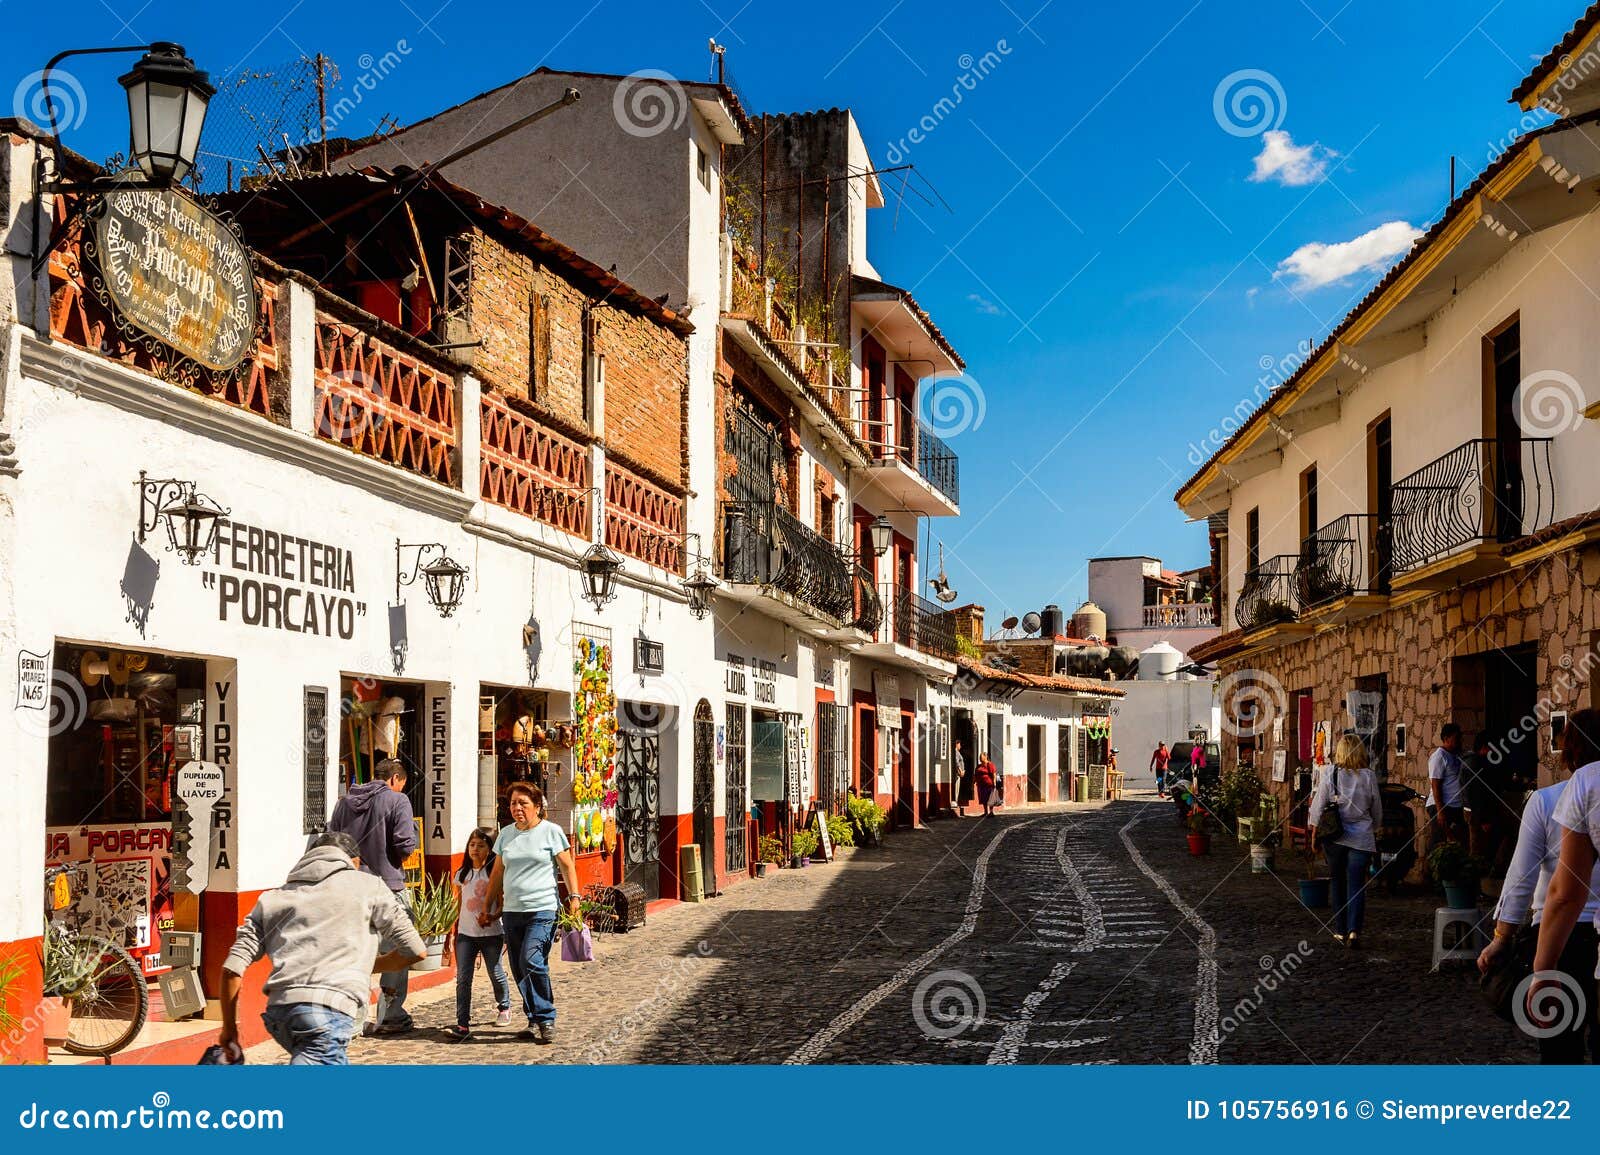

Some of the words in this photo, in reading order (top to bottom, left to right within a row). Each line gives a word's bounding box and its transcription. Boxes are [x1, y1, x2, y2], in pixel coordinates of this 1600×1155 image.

[214, 518, 355, 593] FERRETERIA
[21, 658, 45, 671] BENITO
[21, 671, 46, 683] JUAREZ
[431, 696, 446, 840] FERRETERIA
[800, 727, 808, 781] PLATA
[183, 772, 221, 780] DUPLICADO
[80, 825, 173, 854] "PORCAY
